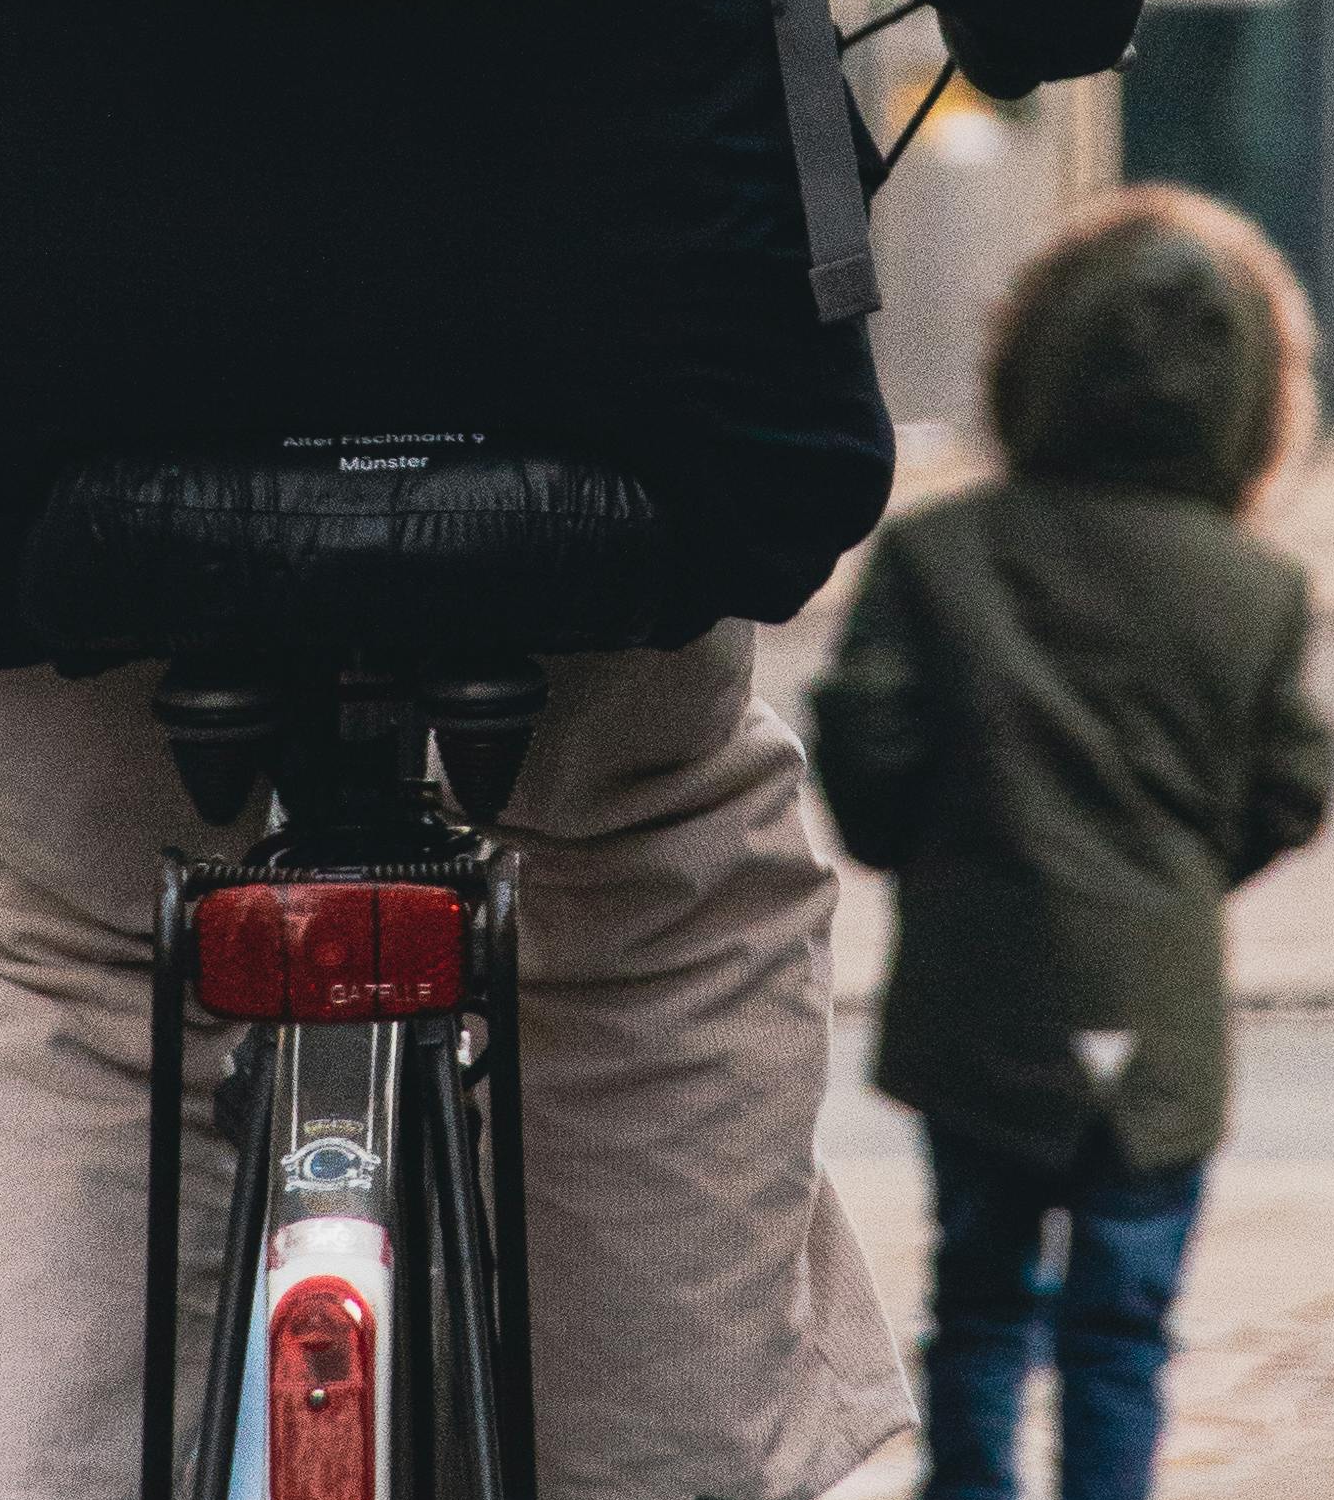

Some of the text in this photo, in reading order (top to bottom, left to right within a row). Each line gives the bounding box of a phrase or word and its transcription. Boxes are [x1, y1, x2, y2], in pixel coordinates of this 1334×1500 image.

[283, 432, 486, 447] Alter Fischmarkt 9
[339, 455, 429, 472] Münster
